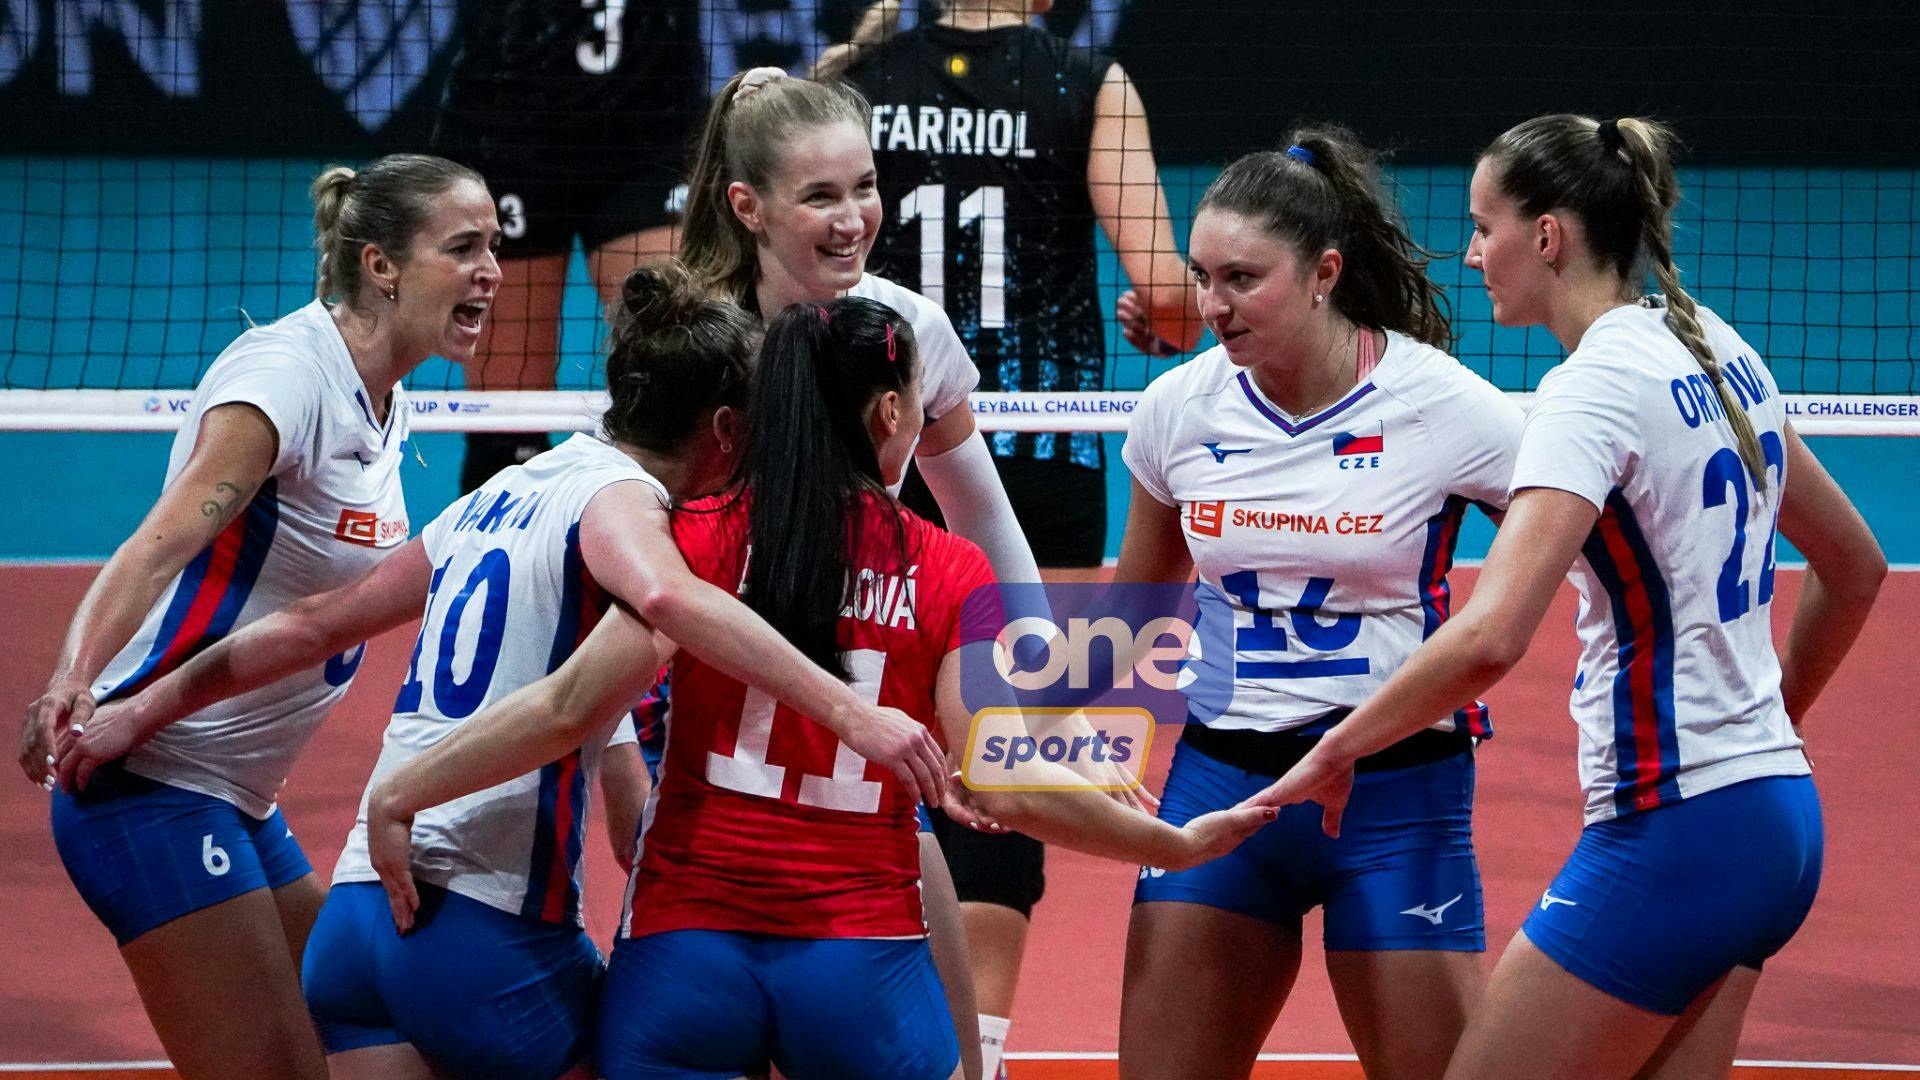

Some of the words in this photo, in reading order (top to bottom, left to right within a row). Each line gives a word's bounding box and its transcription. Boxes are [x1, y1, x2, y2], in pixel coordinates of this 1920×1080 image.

[871, 105, 1036, 158] FARRIOL
[500, 194, 526, 238] 3
[900, 184, 1005, 328] 11
[411, 401, 438, 413] UP
[969, 401, 1038, 413] LEYBALL
[1045, 401, 1137, 413] CHALLENG
[1785, 402, 1802, 415] LL
[1808, 402, 1919, 416] CHALLENGER
[1339, 456, 1379, 470] CZE
[1232, 508, 1330, 535] SKUPINA
[1335, 511, 1384, 535] ČEZ
[1220, 570, 1362, 652] 16
[392, 548, 511, 719] 10
[202, 833, 231, 876] 6
